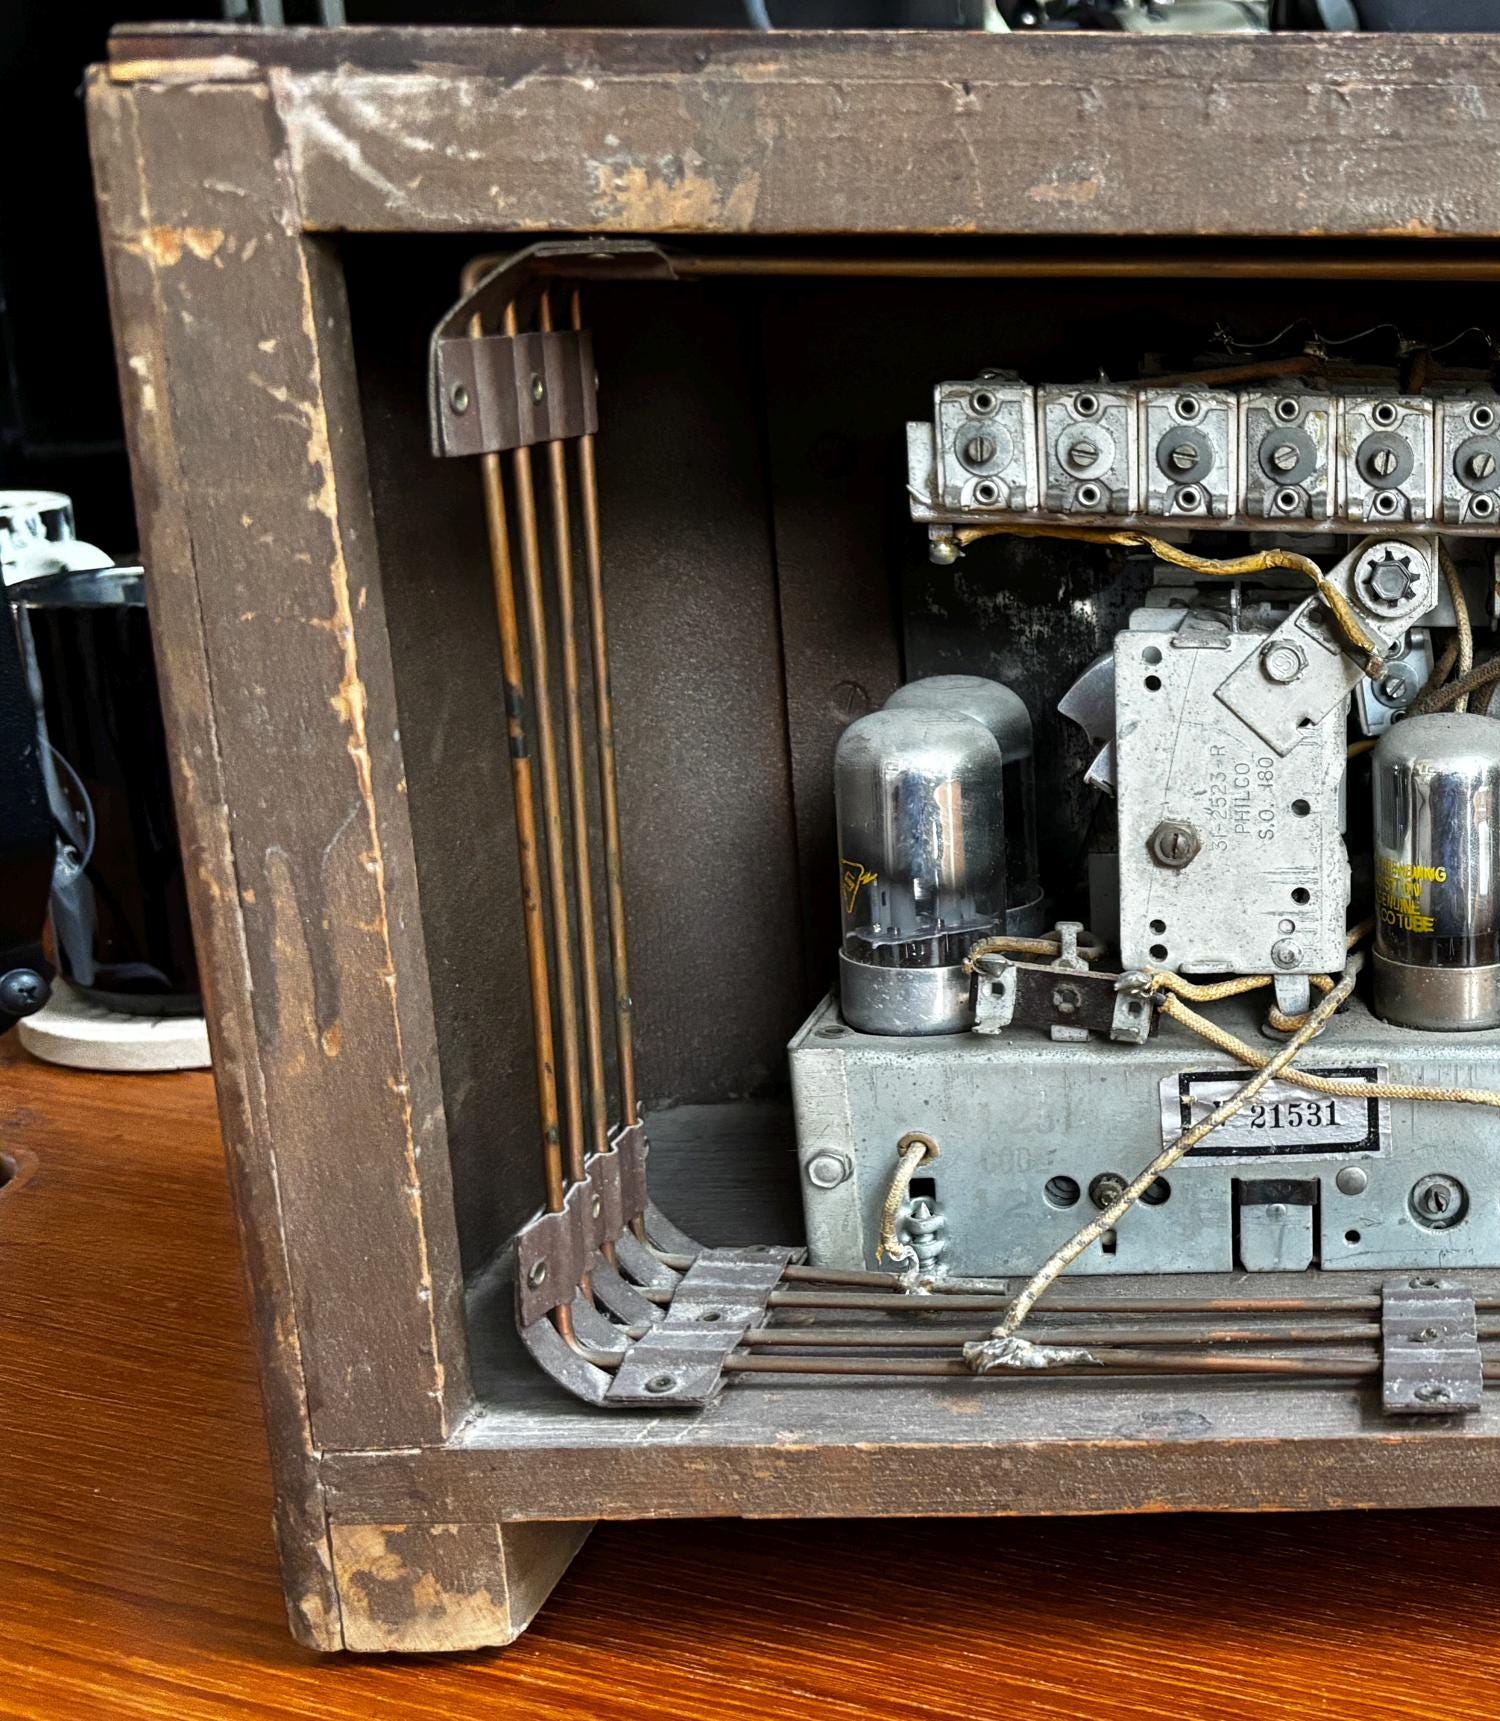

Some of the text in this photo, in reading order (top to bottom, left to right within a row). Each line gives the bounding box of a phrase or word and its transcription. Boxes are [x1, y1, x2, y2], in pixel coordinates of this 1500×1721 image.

[1258, 756, 1275, 788] 180
[1234, 762, 1252, 834] PHILCO
[1396, 913, 1435, 933] TUBE
[1250, 1100, 1342, 1129] 21531
